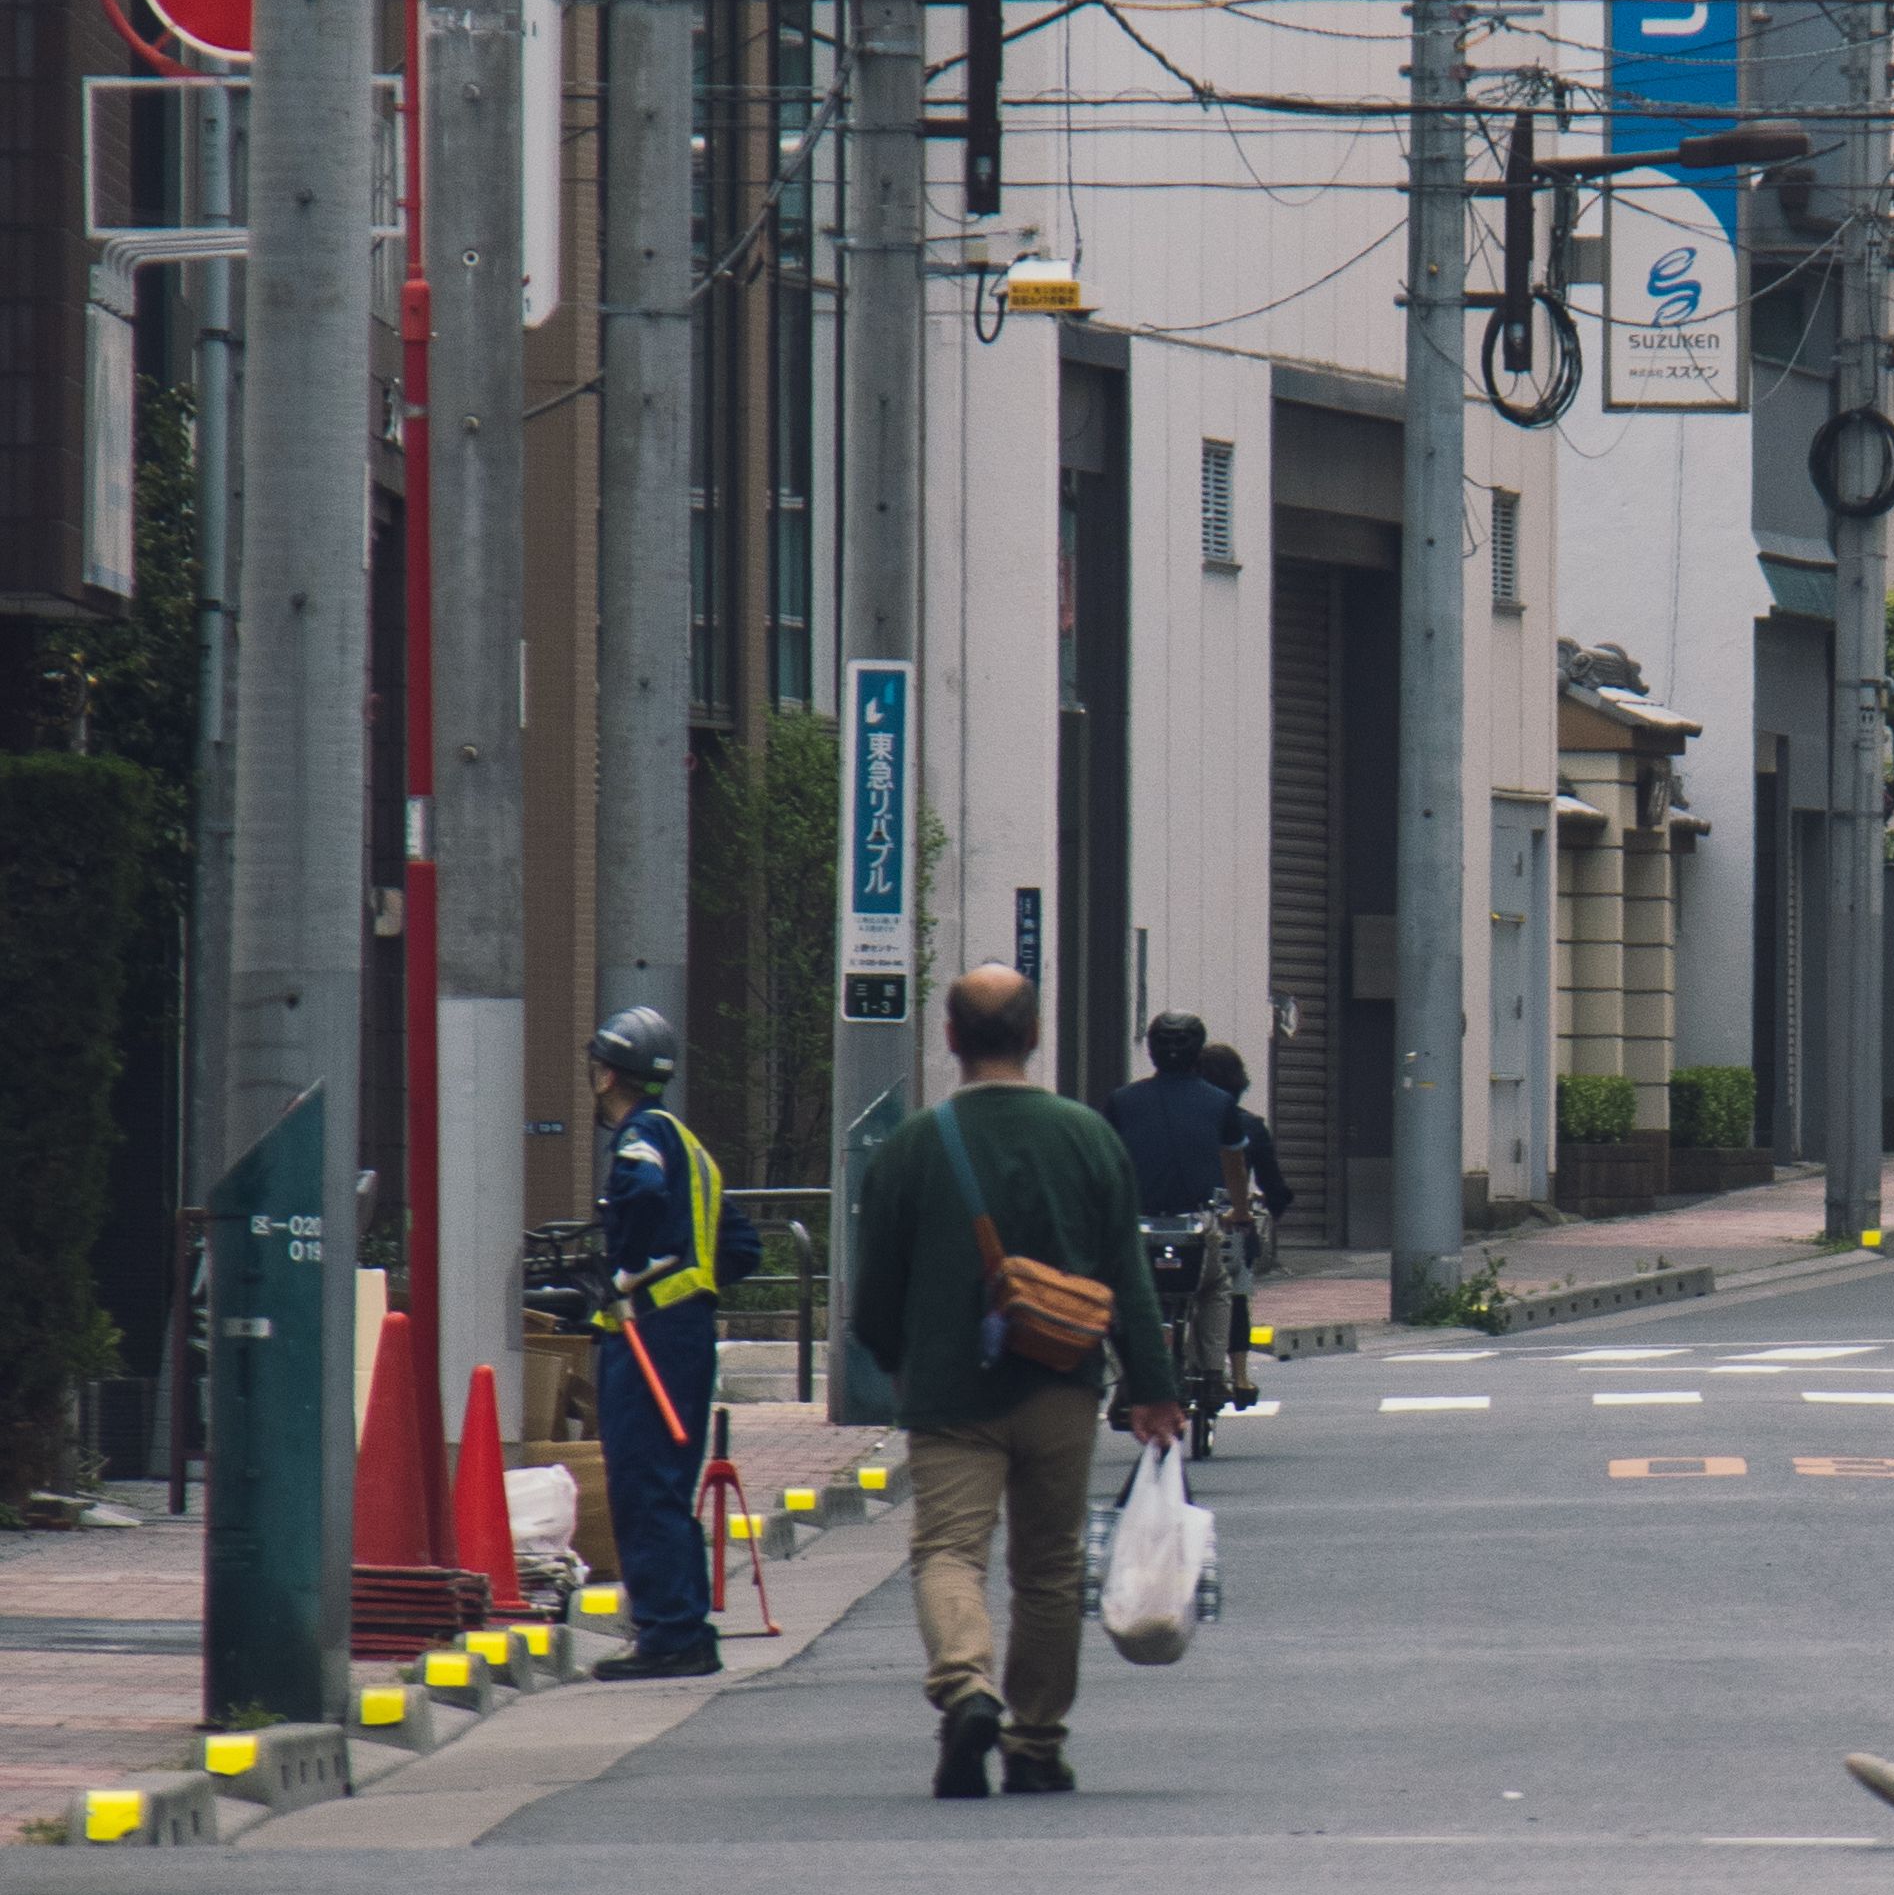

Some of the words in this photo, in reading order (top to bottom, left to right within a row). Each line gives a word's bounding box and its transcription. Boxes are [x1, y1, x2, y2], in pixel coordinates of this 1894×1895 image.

[1628, 334, 1720, 349] SUZUKEN
[863, 731, 895, 895] 東急リバブル
[860, 1000, 892, 1014] 1-3
